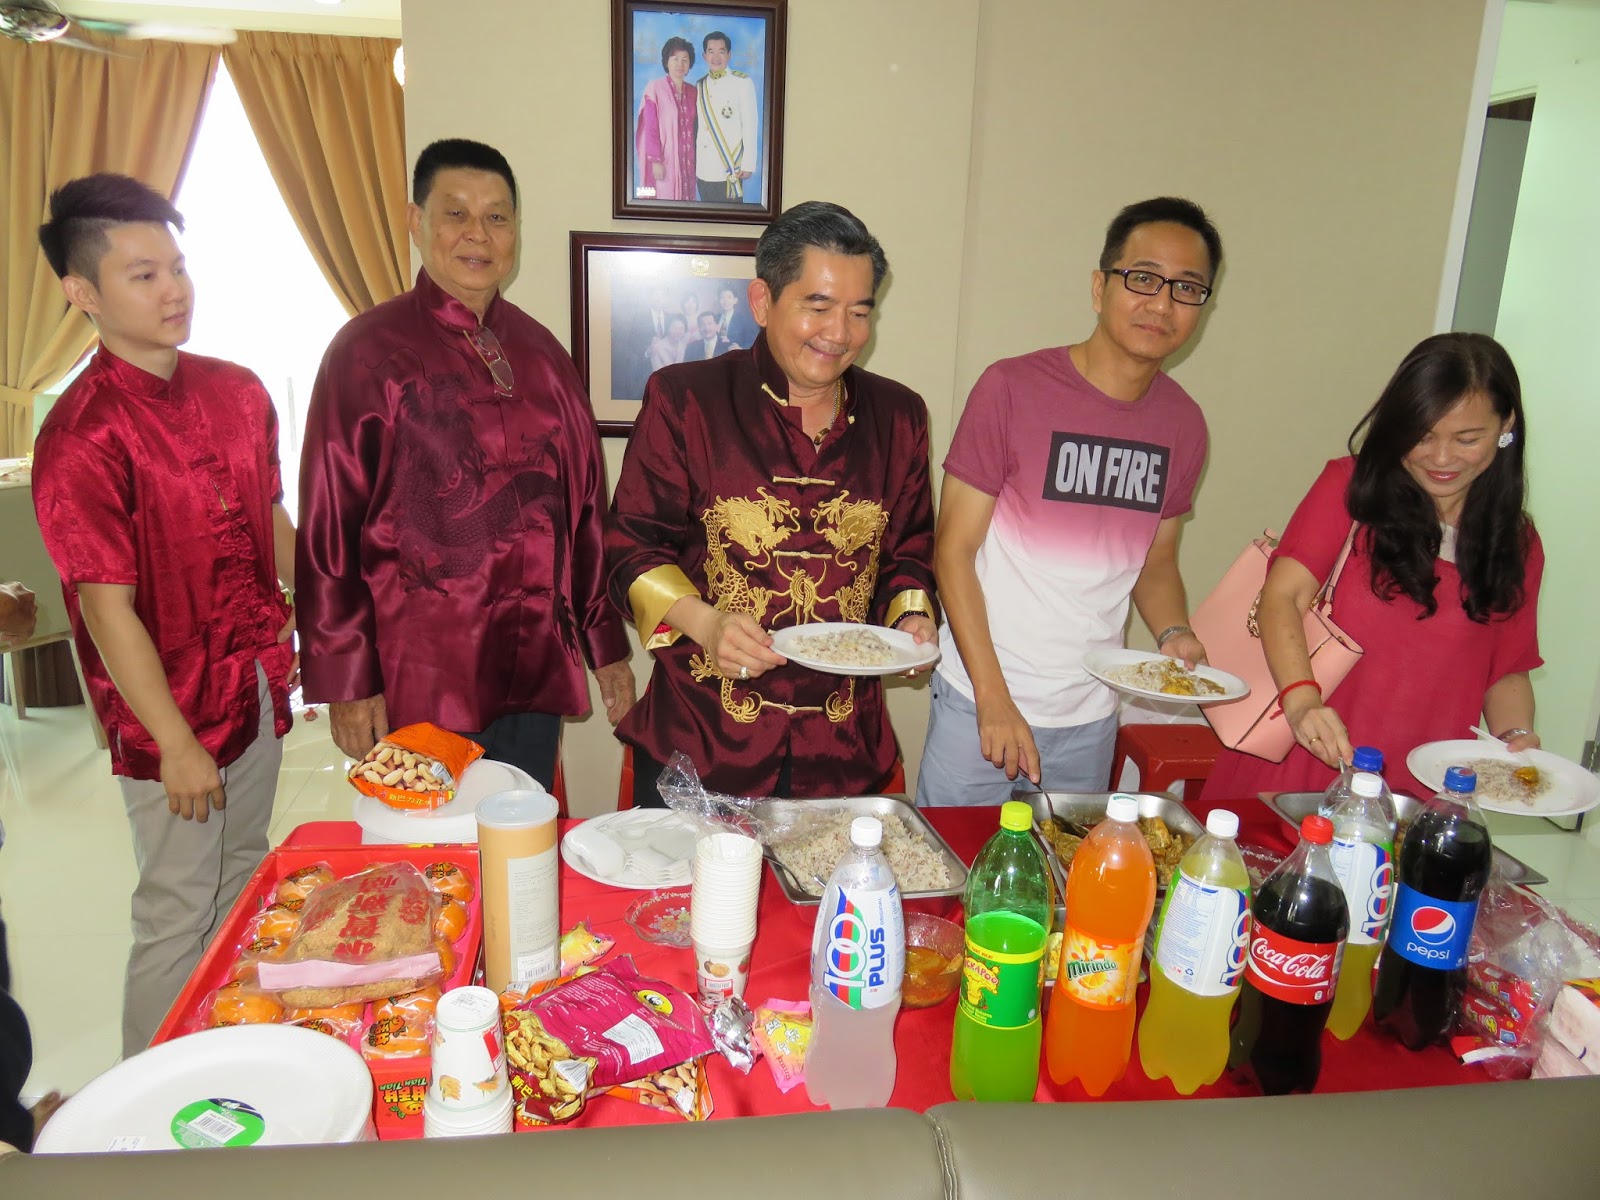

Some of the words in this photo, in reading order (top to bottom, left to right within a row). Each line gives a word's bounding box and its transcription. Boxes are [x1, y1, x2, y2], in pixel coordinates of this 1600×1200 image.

[1055, 441, 1103, 496] ON
[1102, 447, 1162, 504] FIRE
[1360, 862, 1395, 933] 100
[823, 912, 868, 989] 100
[869, 927, 886, 988] PLUS
[1250, 937, 1332, 979] Coca-Cola
[1406, 942, 1450, 960] pepsi
[963, 958, 999, 985] ICKAPOO
[1066, 959, 1118, 981] Mirinda
[379, 1081, 403, 1091] Tian
[404, 1077, 428, 1088] Tian
